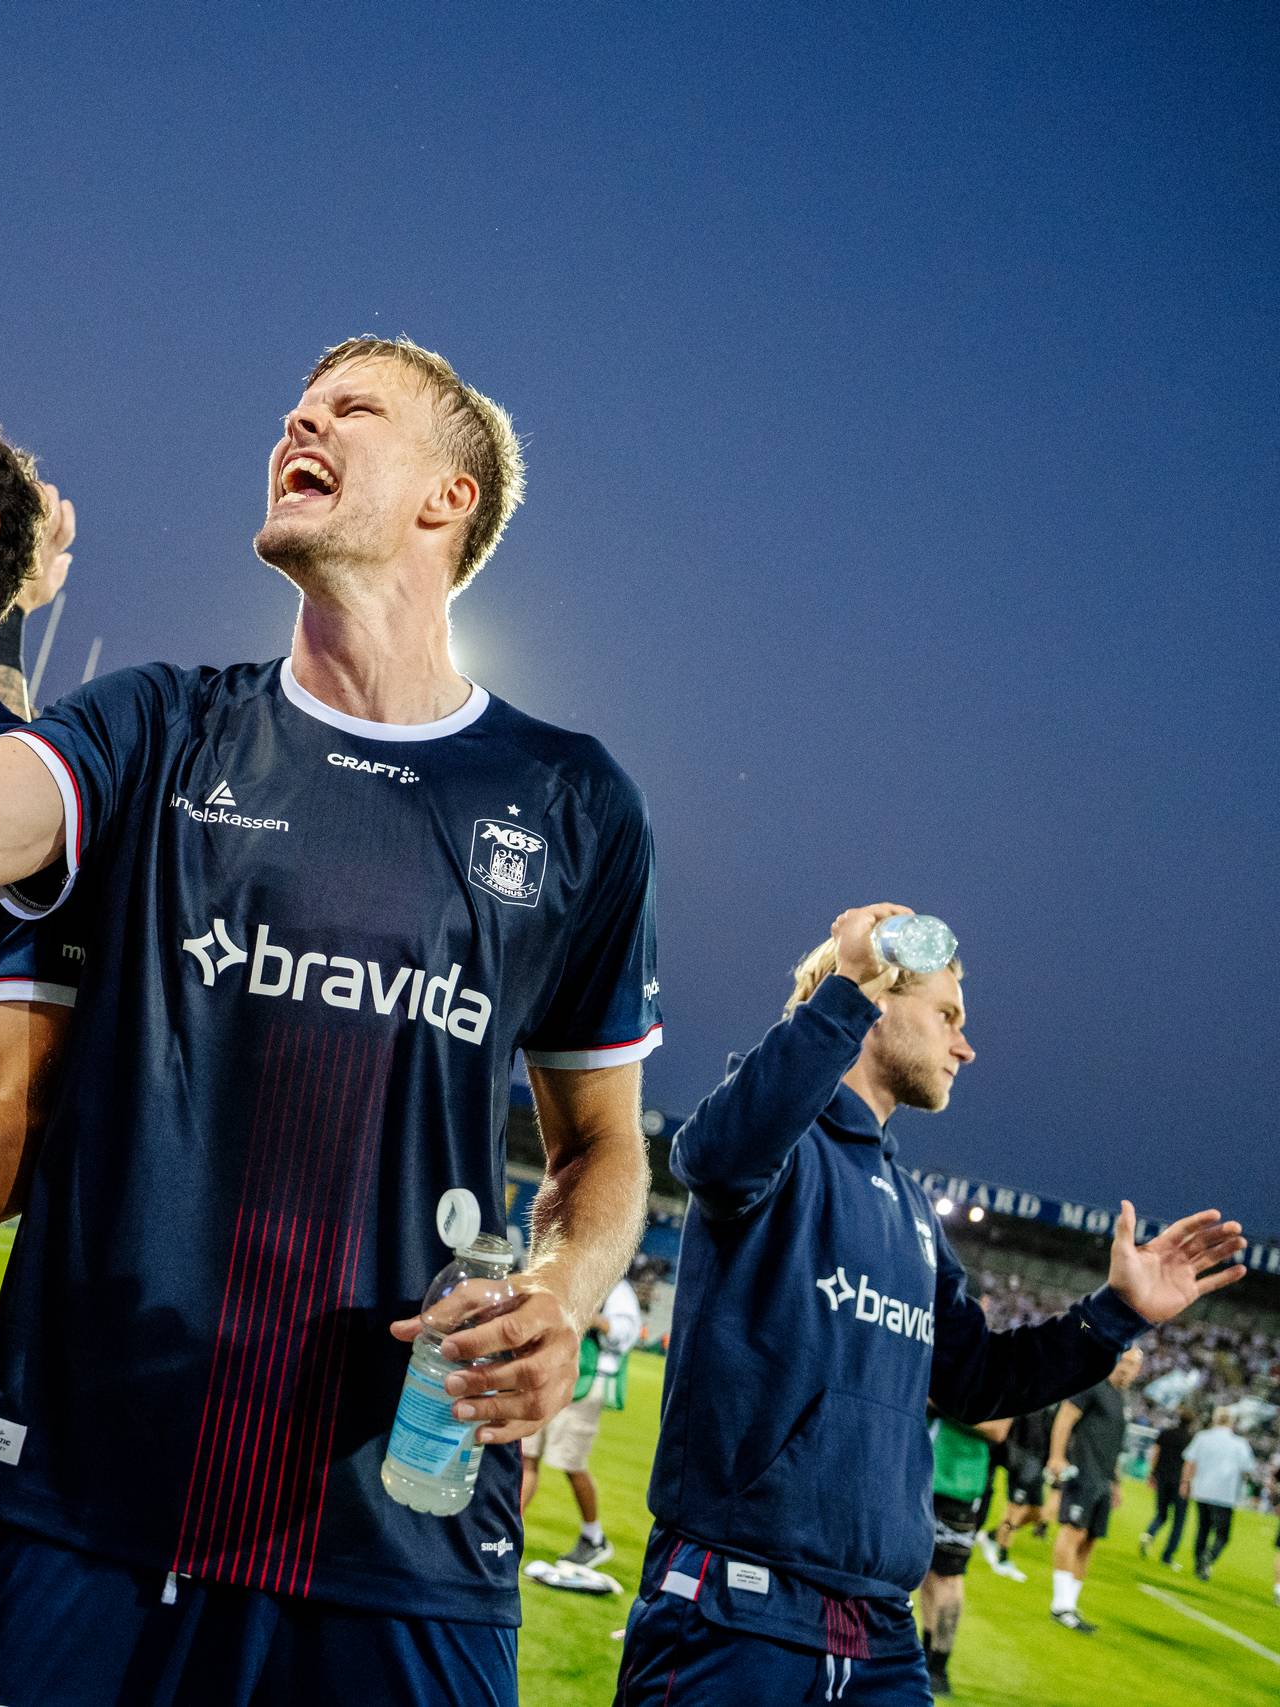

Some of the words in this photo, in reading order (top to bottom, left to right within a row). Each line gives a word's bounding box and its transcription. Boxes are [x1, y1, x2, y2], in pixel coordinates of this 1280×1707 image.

[327, 753, 401, 778] CRAFT
[486, 879, 524, 898] AARHUS
[248, 924, 492, 1046] bravida
[855, 1274, 936, 1347] bravid
[480, 1542, 498, 1551] SIDE
